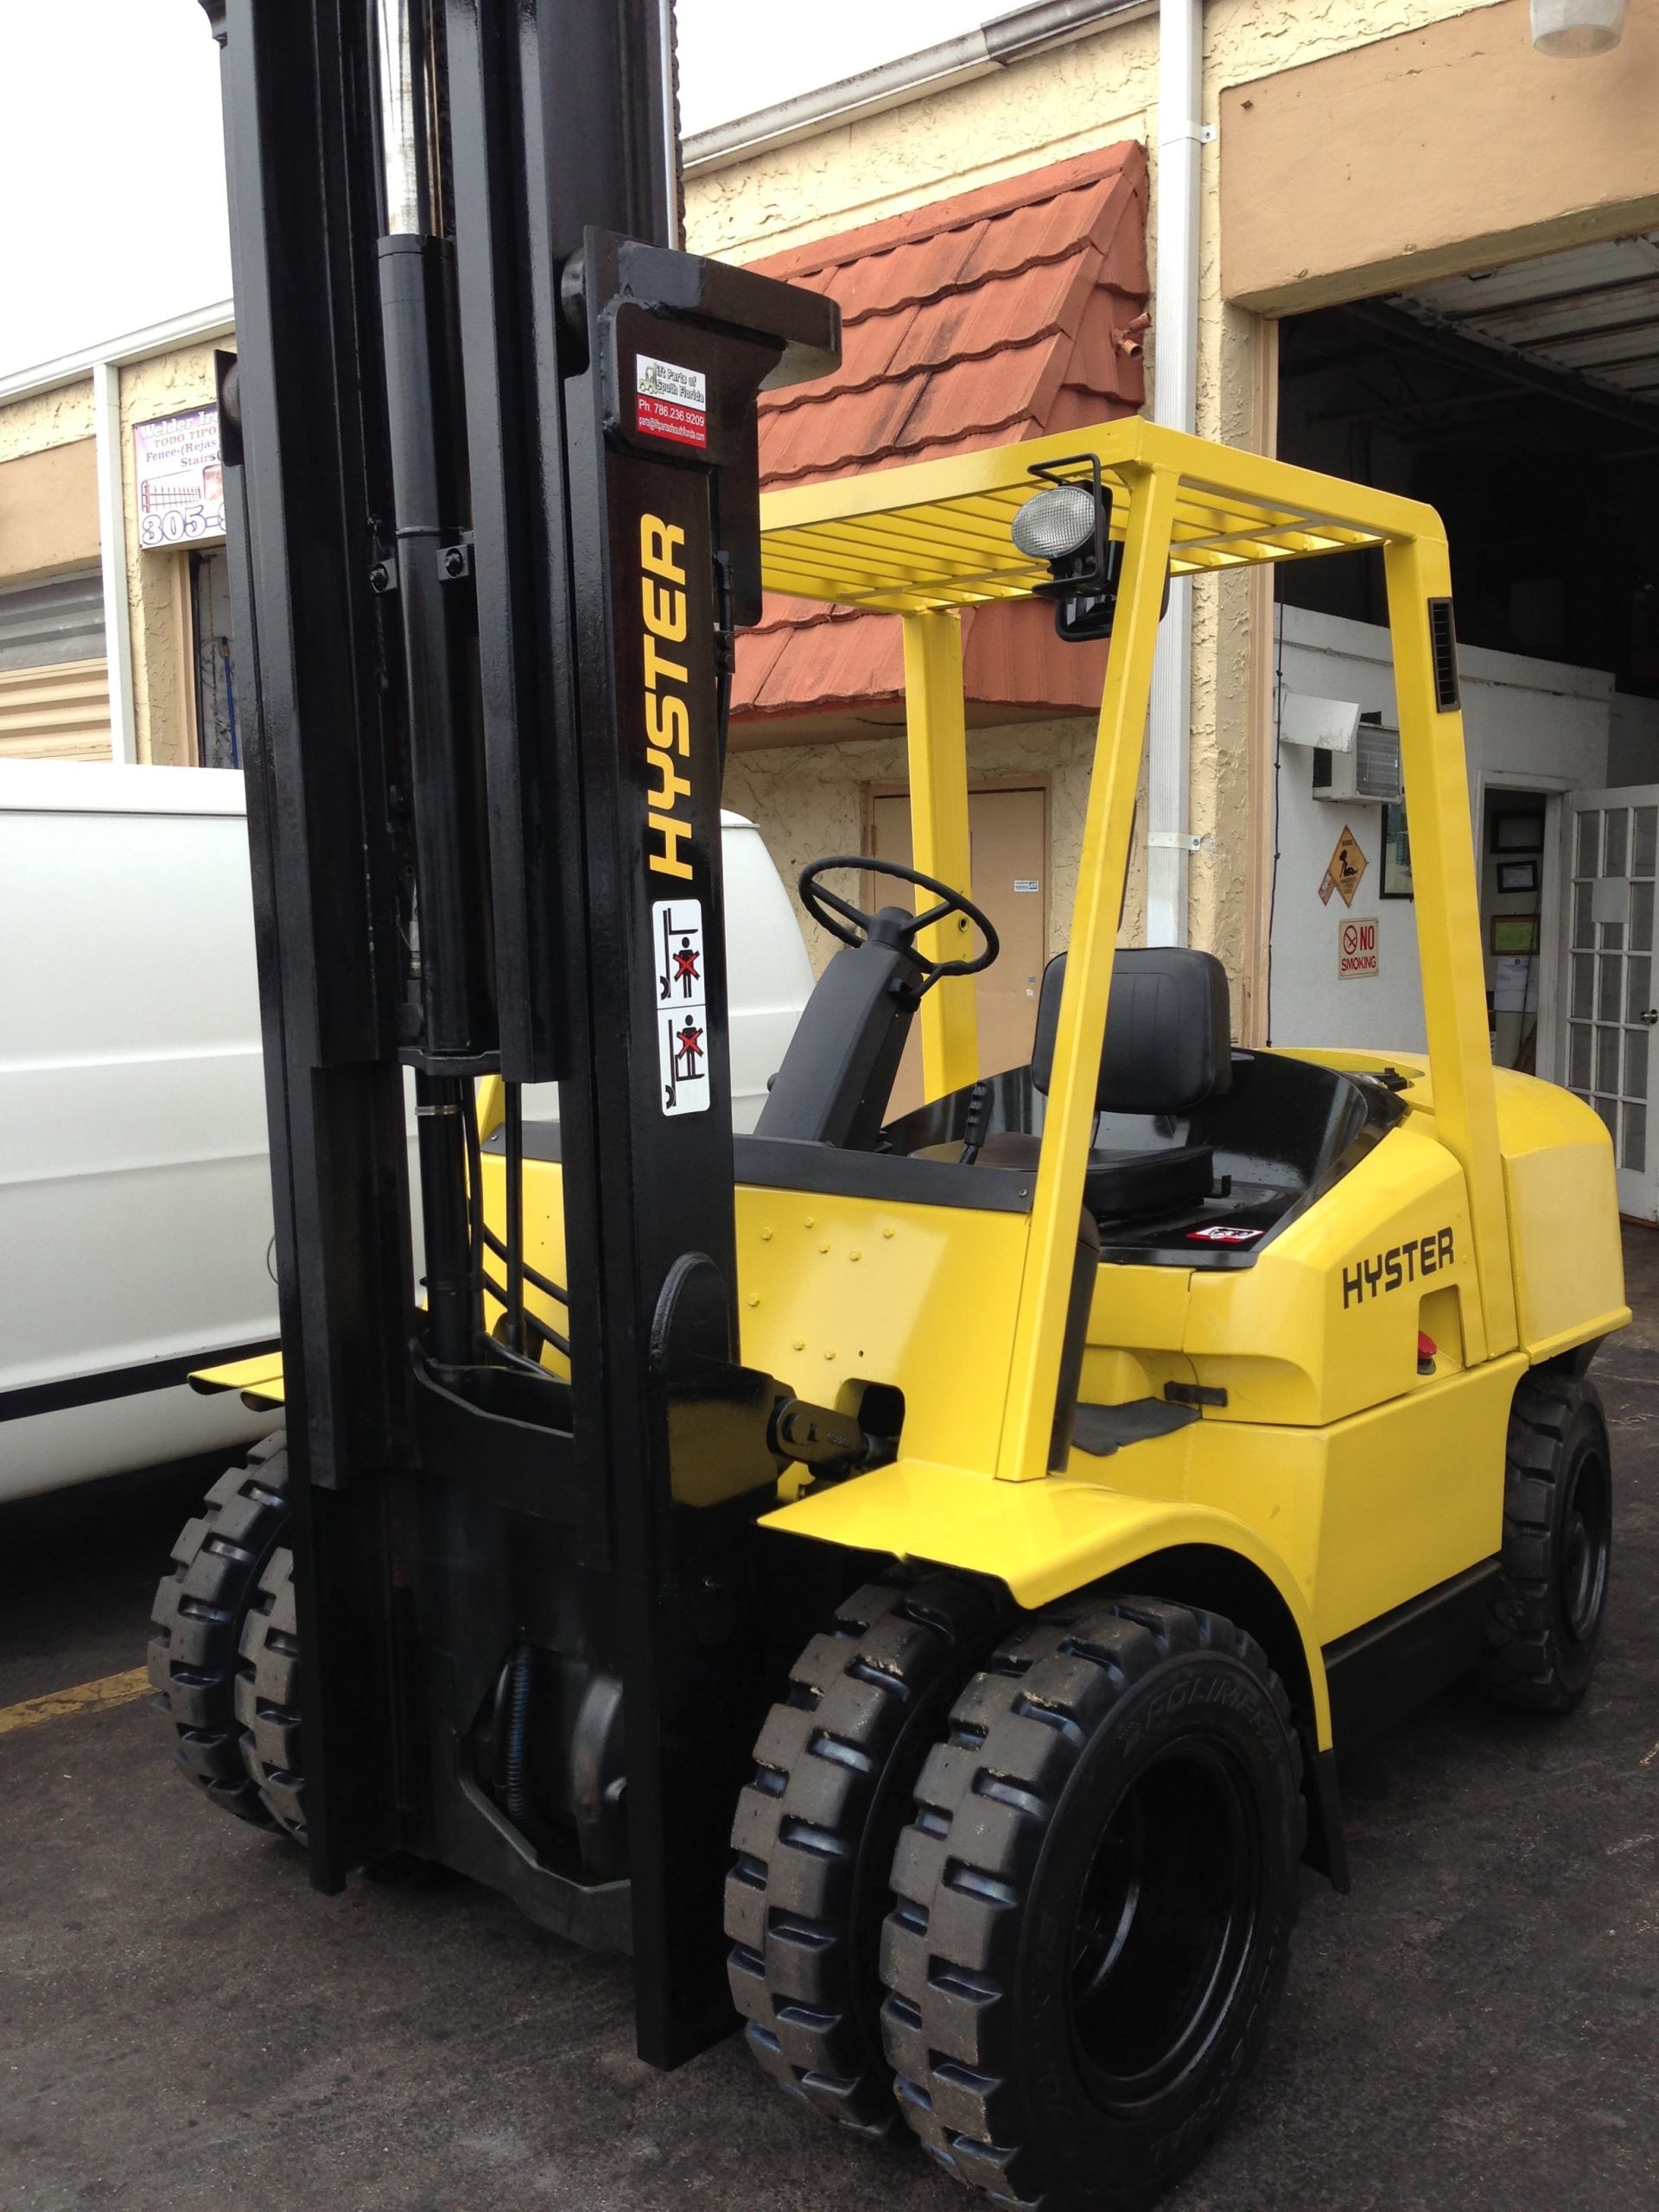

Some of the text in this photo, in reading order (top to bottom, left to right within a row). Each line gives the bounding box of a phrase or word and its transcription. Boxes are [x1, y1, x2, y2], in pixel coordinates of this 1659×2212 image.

[657, 378, 704, 403] South Florida
[689, 376, 697, 388] of
[654, 403, 705, 427] 786.236.9209
[141, 418, 194, 440] Welder
[154, 426, 217, 448] TODO TIPO
[640, 512, 694, 881] HYSTER
[1359, 925, 1376, 950] NO
[1341, 956, 1376, 972] SMOKING
[1342, 1226, 1455, 1310] HYSTER
